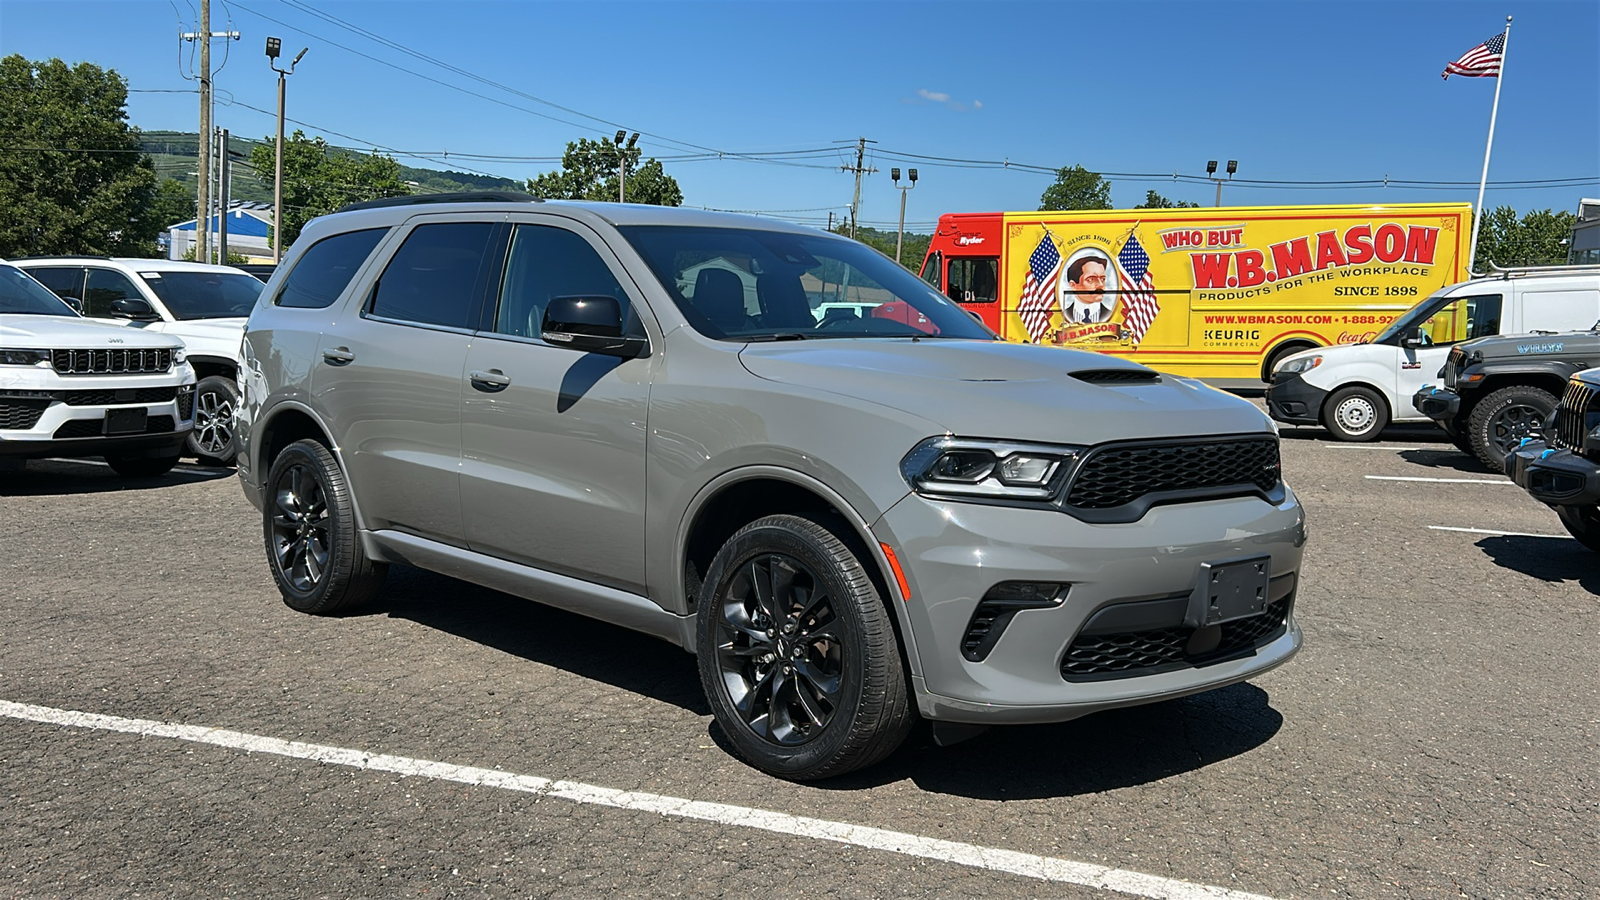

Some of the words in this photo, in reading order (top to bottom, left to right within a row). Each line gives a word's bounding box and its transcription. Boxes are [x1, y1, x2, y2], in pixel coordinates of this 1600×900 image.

[960, 236, 985, 246] Ryder
[1067, 235, 1091, 247] SINCE
[1162, 230, 1203, 249] WHO
[1207, 228, 1243, 246] BUT
[1199, 286, 1271, 301] PRODUCTS
[1276, 278, 1303, 292] FOR
[1307, 271, 1335, 285] THE
[1340, 266, 1430, 278] WORKPLACE
[1334, 286, 1379, 296] SINCE
[1384, 286, 1418, 296] 1898
[1204, 315, 1332, 324] WWW.WBMASON.COM
[1204, 330, 1260, 340] KEURIG
[1516, 342, 1564, 354] WILLYS
